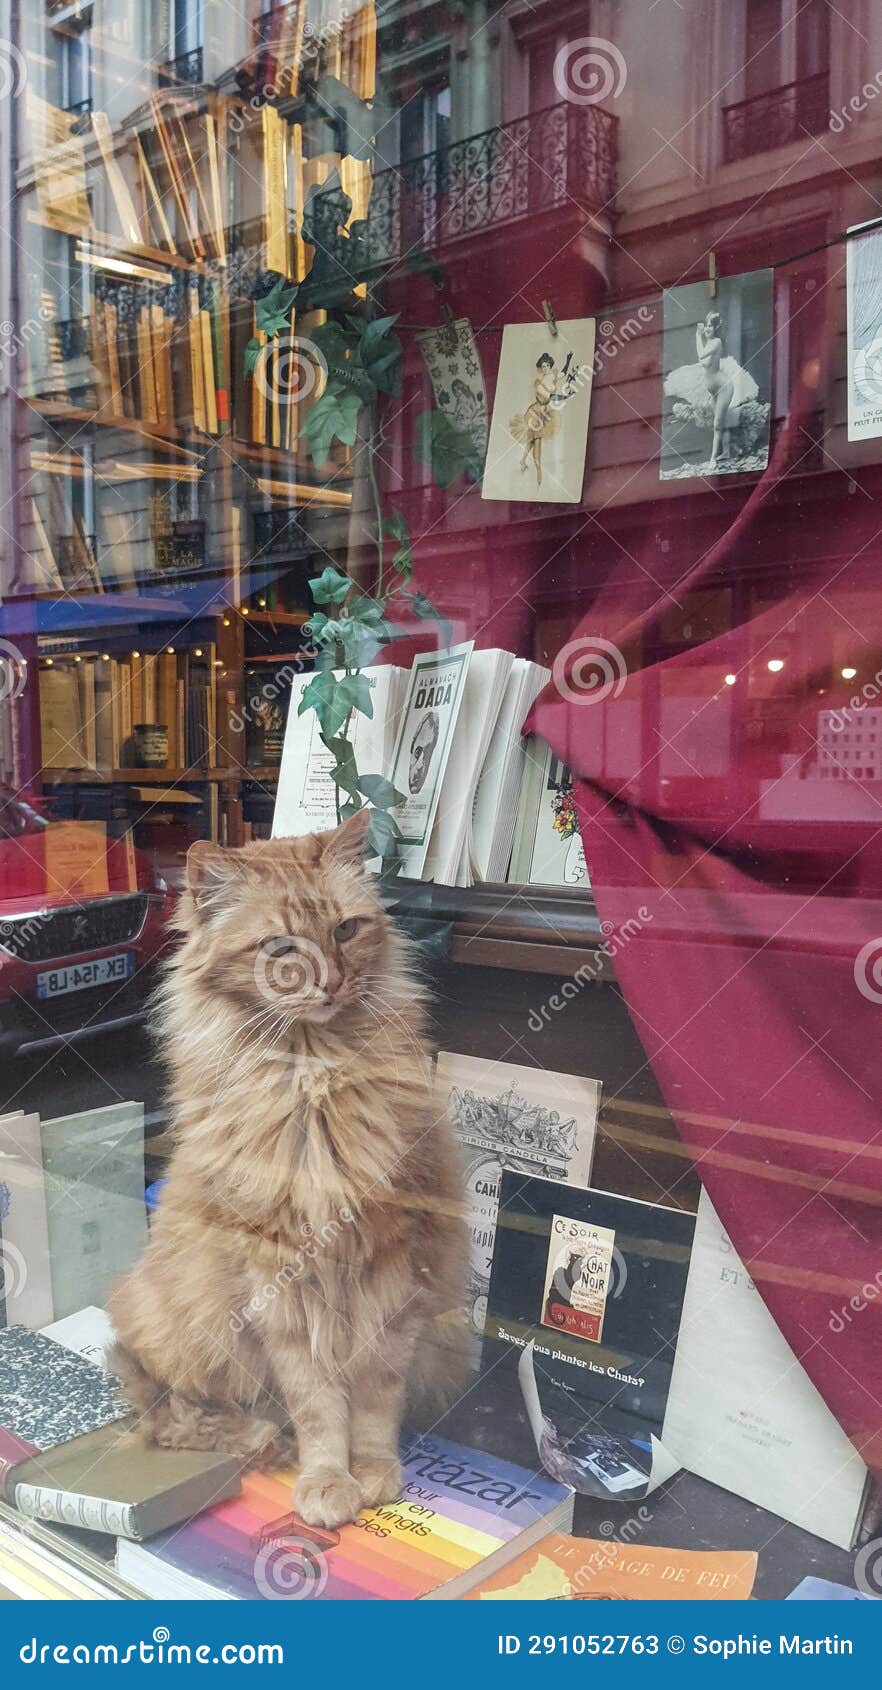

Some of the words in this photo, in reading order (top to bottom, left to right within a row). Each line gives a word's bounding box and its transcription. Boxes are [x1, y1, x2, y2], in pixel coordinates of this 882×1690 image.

[414, 684, 453, 710] DADA
[503, 1146, 548, 1164] CANDELA
[586, 1256, 609, 1274] CHAT
[580, 1272, 605, 1291] NOIR
[498, 1327, 550, 1355] Savez-ous
[551, 1350, 588, 1369] planter
[589, 1361, 605, 1375] les
[606, 1366, 645, 1387] Chats?
[404, 1482, 443, 1502] tour
[375, 1507, 432, 1537] vingts
[408, 1504, 436, 1520] en
[353, 1518, 392, 1538] des
[553, 1544, 580, 1559] LE
[660, 1565, 690, 1583] DE
